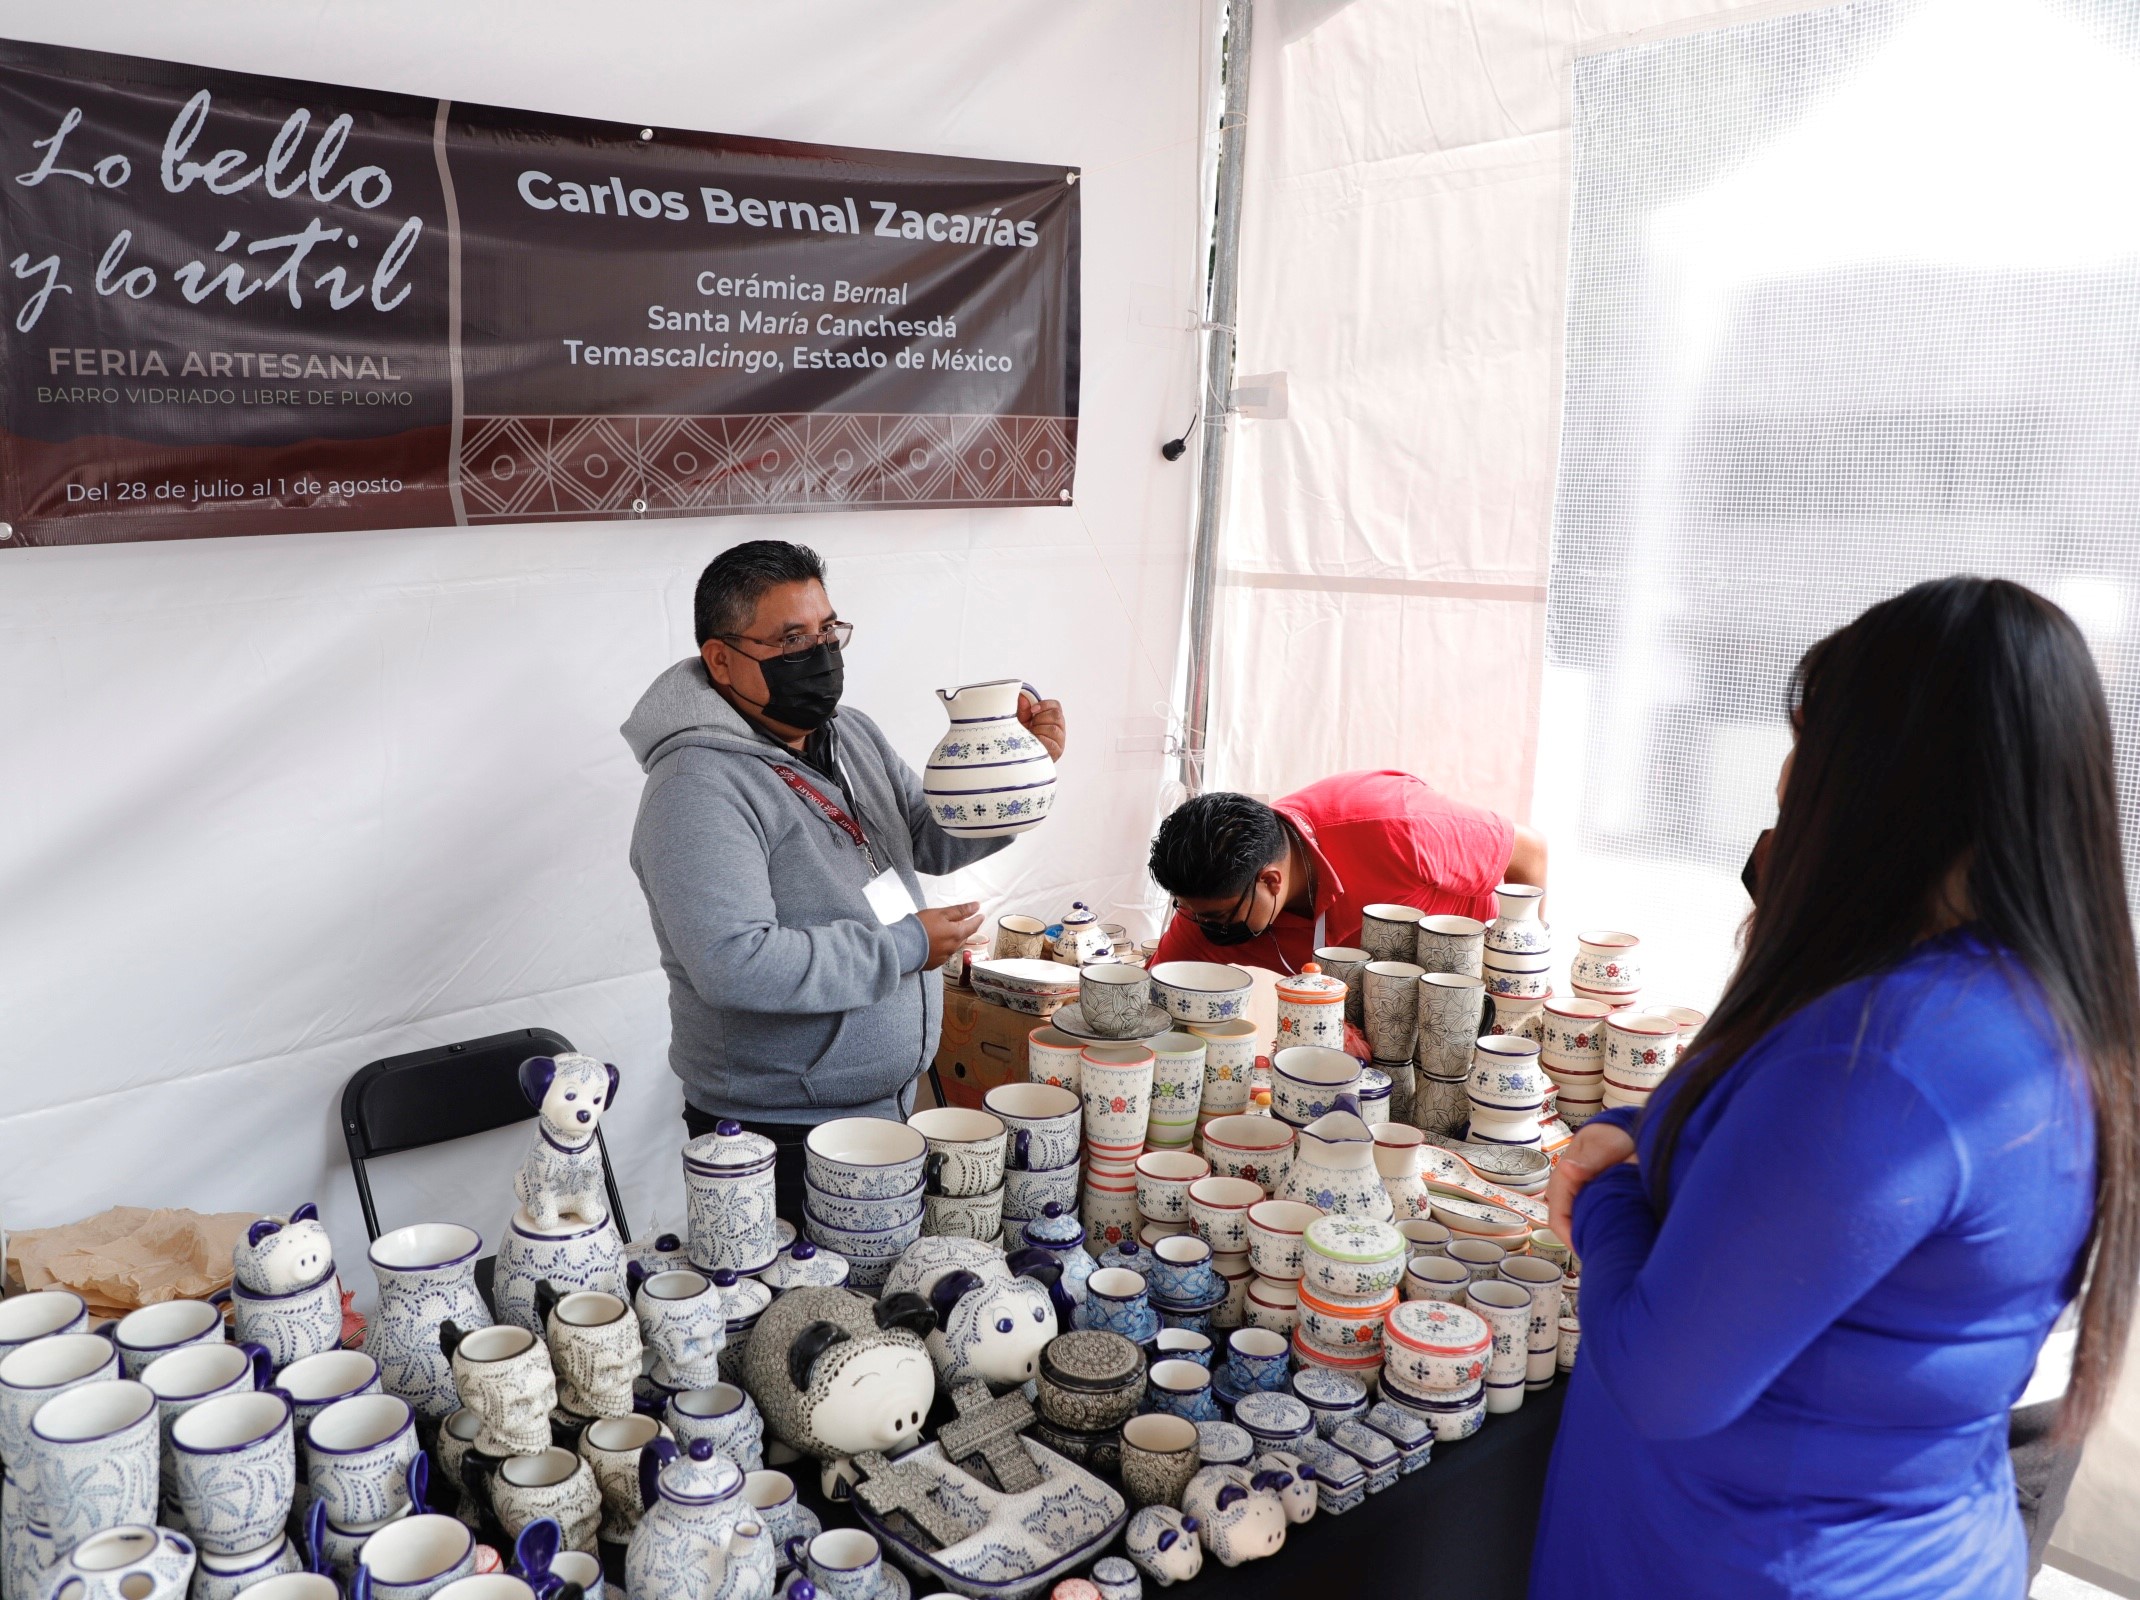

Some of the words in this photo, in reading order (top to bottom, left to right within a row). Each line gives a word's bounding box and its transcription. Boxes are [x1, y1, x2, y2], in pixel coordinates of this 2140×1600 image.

[15, 107, 131, 188] Lo
[160, 88, 392, 209] bello
[517, 170, 690, 221] Carlos
[699, 187, 860, 235] Bernal
[869, 200, 1040, 248] Zacarías
[10, 252, 73, 333] y
[95, 229, 156, 299] lo
[174, 216, 423, 312] útil
[696, 270, 825, 302] Cerámica
[833, 280, 908, 305] Bernal
[648, 305, 730, 333] Santa
[739, 310, 809, 335] María
[816, 313, 957, 338] Canchesdá
[49, 347, 170, 377] FERIA
[180, 351, 402, 381] ARTESANAL
[563, 339, 784, 374] Temascalcingo,
[793, 346, 888, 369] Estado
[895, 346, 925, 370] de
[931, 348, 1013, 372] México
[37, 386, 120, 404] BARRO
[125, 388, 236, 404] VIDRIADO
[242, 389, 301, 405] LIBRE
[307, 390, 335, 406] DE
[341, 391, 413, 407] PLOMO
[66, 481, 109, 502] Del
[116, 481, 147, 500] 28
[154, 480, 186, 499] de
[191, 478, 244, 503] julio
[252, 478, 271, 496] al
[277, 478, 286, 495] 1
[293, 477, 321, 495] de
[328, 477, 403, 498] agosto
[795, 784, 824, 807] FONART
